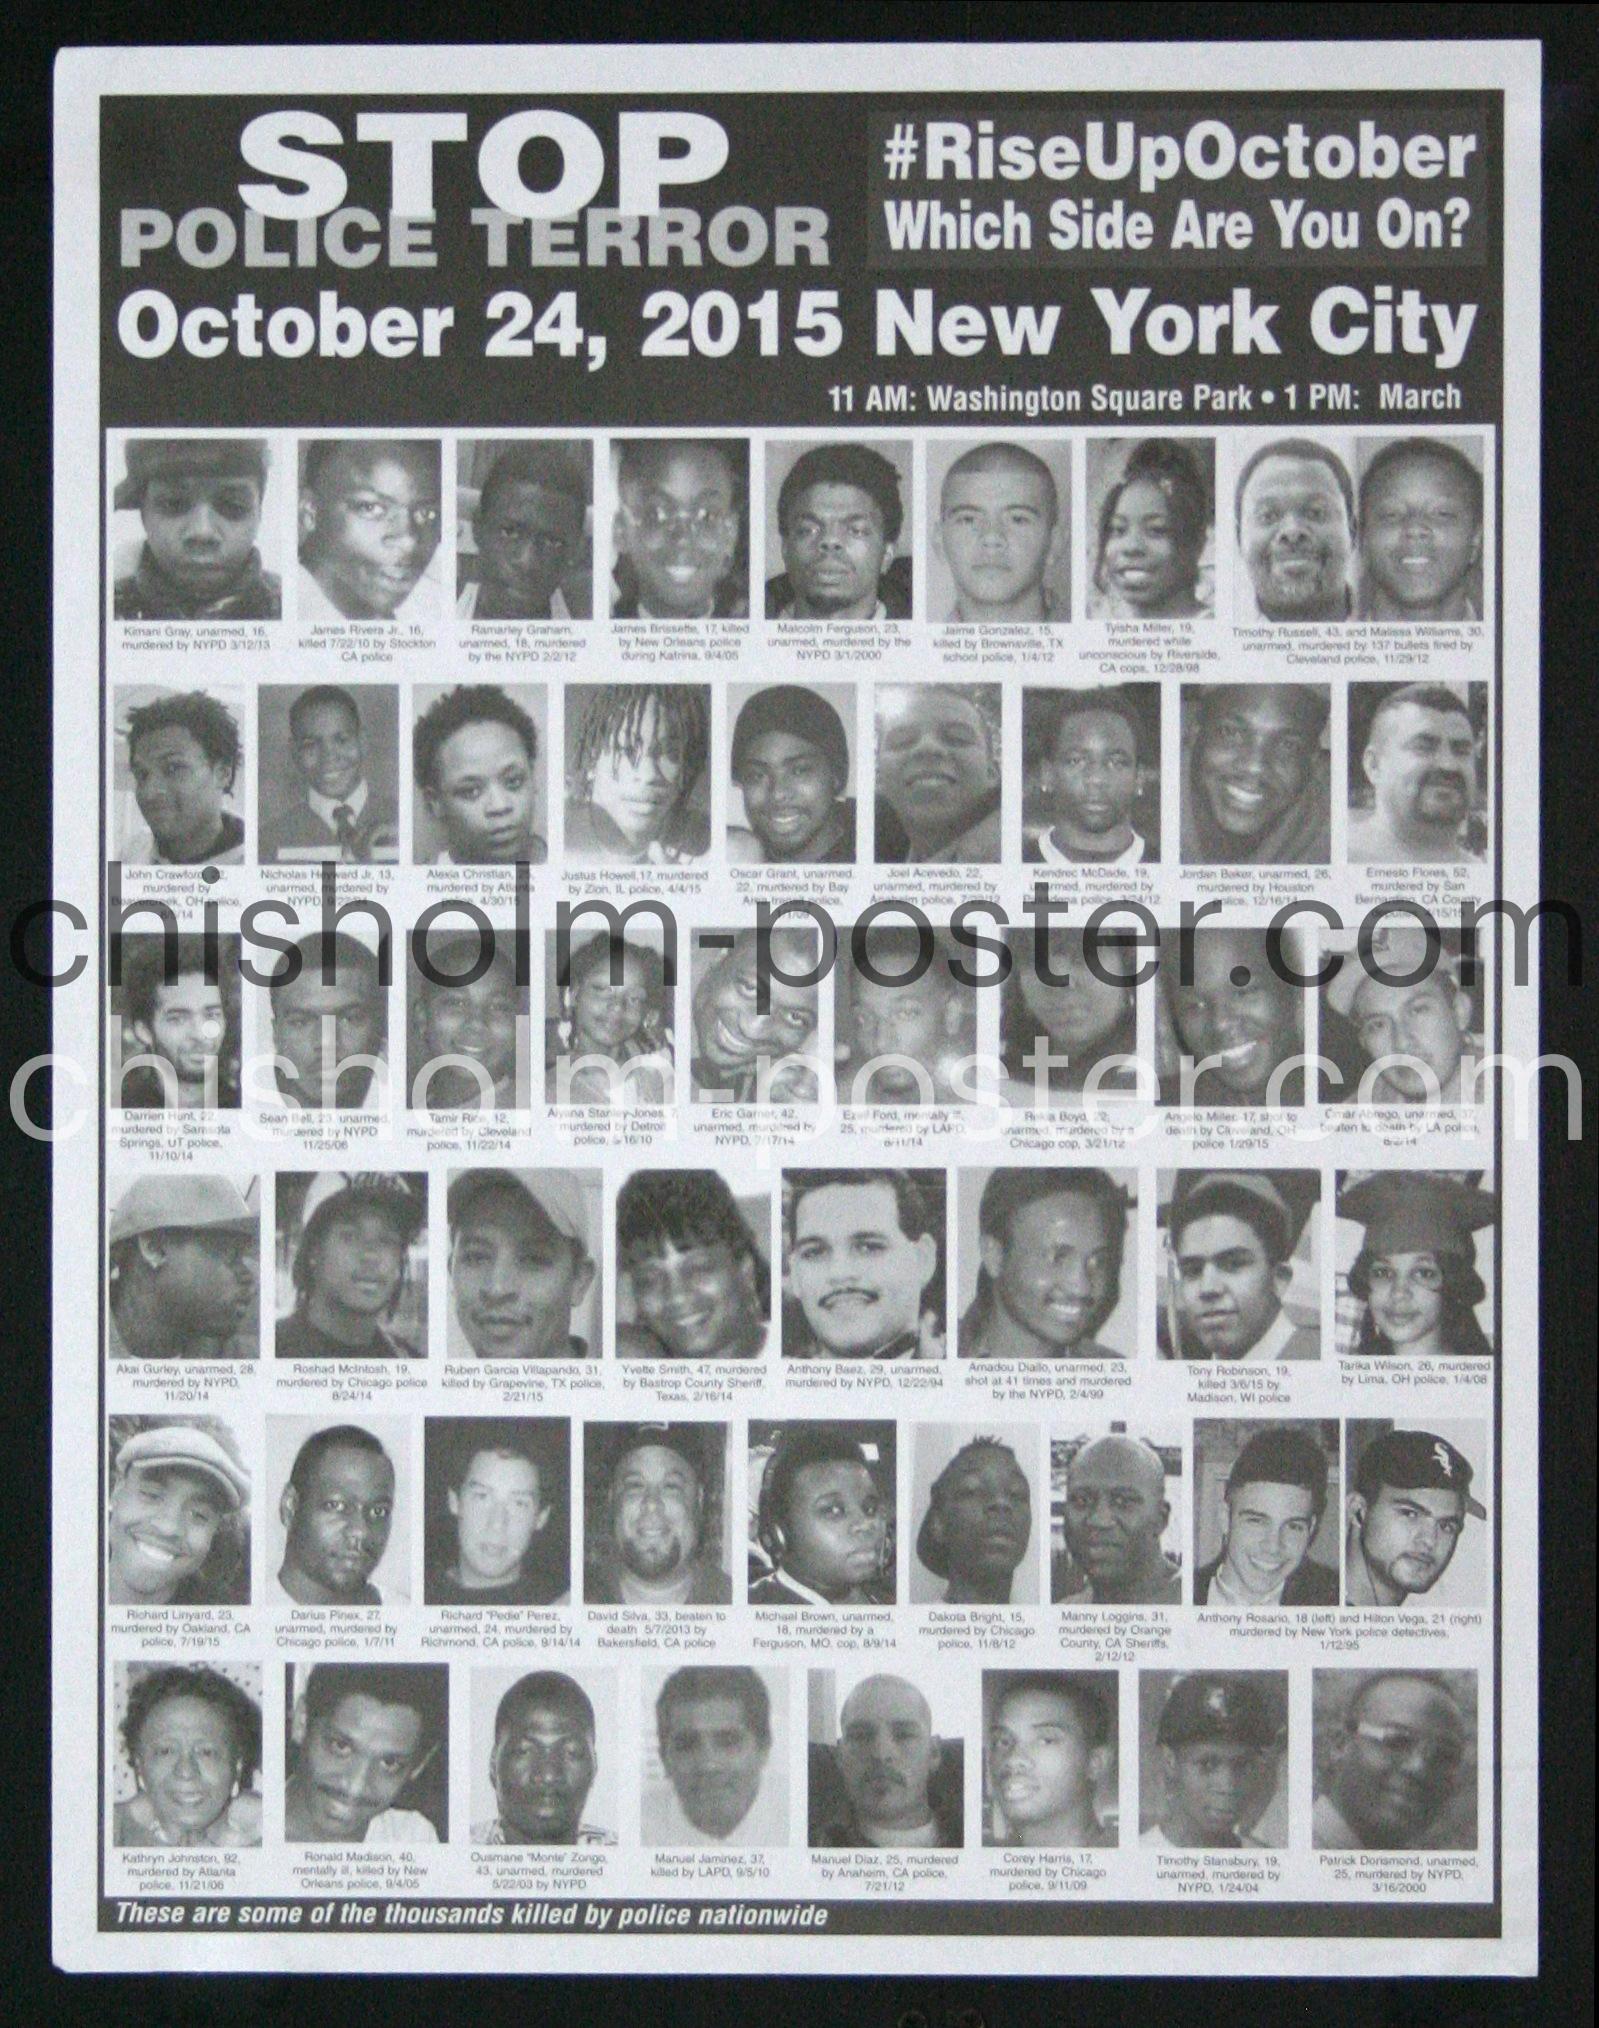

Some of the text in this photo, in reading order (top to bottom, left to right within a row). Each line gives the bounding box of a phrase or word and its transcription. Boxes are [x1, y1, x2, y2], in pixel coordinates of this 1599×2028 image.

[884, 120, 1477, 193] #RiseUpOctober
[238, 110, 729, 220] STOP
[884, 197, 1471, 251] Which Side Are You On?
[120, 206, 829, 268] POLICE TERROR
[117, 285, 1478, 373] October 24, 2015 New York City
[828, 384, 1461, 420] 11 AM: Washington Square Park 1 PM: March
[122, 639, 173, 649] murdered
[176, 639, 189, 651] by
[193, 639, 227, 649] NYPD
[298, 638, 327, 648] killed
[373, 638, 386, 650] by
[389, 638, 437, 648] Stockton
[619, 636, 742, 648] by New Orleans police
[468, 650, 481, 663] by
[484, 650, 502, 661] the
[505, 650, 539, 661] NYPD
[943, 651, 978, 661] school
[886, 868, 910, 879] Joel
[142, 883, 211, 895] murdered by
[568, 884, 581, 895] by
[1196, 882, 1314, 894] murdered by Houston
[1371, 881, 1465, 892] murdered by San
[167, 1137, 183, 1147] UT
[1010, 1138, 1055, 1150] Chicago
[1193, 1138, 1225, 1150] police
[133, 1377, 184, 1387] murdered
[187, 1377, 200, 1389] by
[276, 1378, 428, 1389] murdered by Chicago police
[785, 1378, 837, 1387] murdered
[840, 1378, 853, 1389] by
[992, 1389, 1005, 1401] by
[1009, 1389, 1026, 1399] the
[1240, 1393, 1255, 1402] WI
[1258, 1393, 1291, 1404] police
[918, 1626, 1035, 1638] murdered by Chicago
[1229, 1627, 1282, 1636] murdered
[1285, 1627, 1298, 1638] by
[1301, 1627, 1326, 1636] New
[1329, 1627, 1352, 1636] York
[1355, 1627, 1388, 1638] police
[276, 1637, 321, 1648] Chicago
[664, 1638, 680, 1647] CA
[684, 1638, 716, 1649] police
[127, 1867, 236, 1878] murdered by Atlanta
[651, 1867, 679, 1877] killed
[682, 1867, 694, 1879] by
[989, 1867, 1107, 1879] murdered by Chicago
[301, 1878, 344, 1888] Orleans
[536, 1879, 549, 1891] by
[552, 1879, 587, 1889] NYPD
[116, 1902, 828, 1929] These are some of the thousands killed by police nationwide
